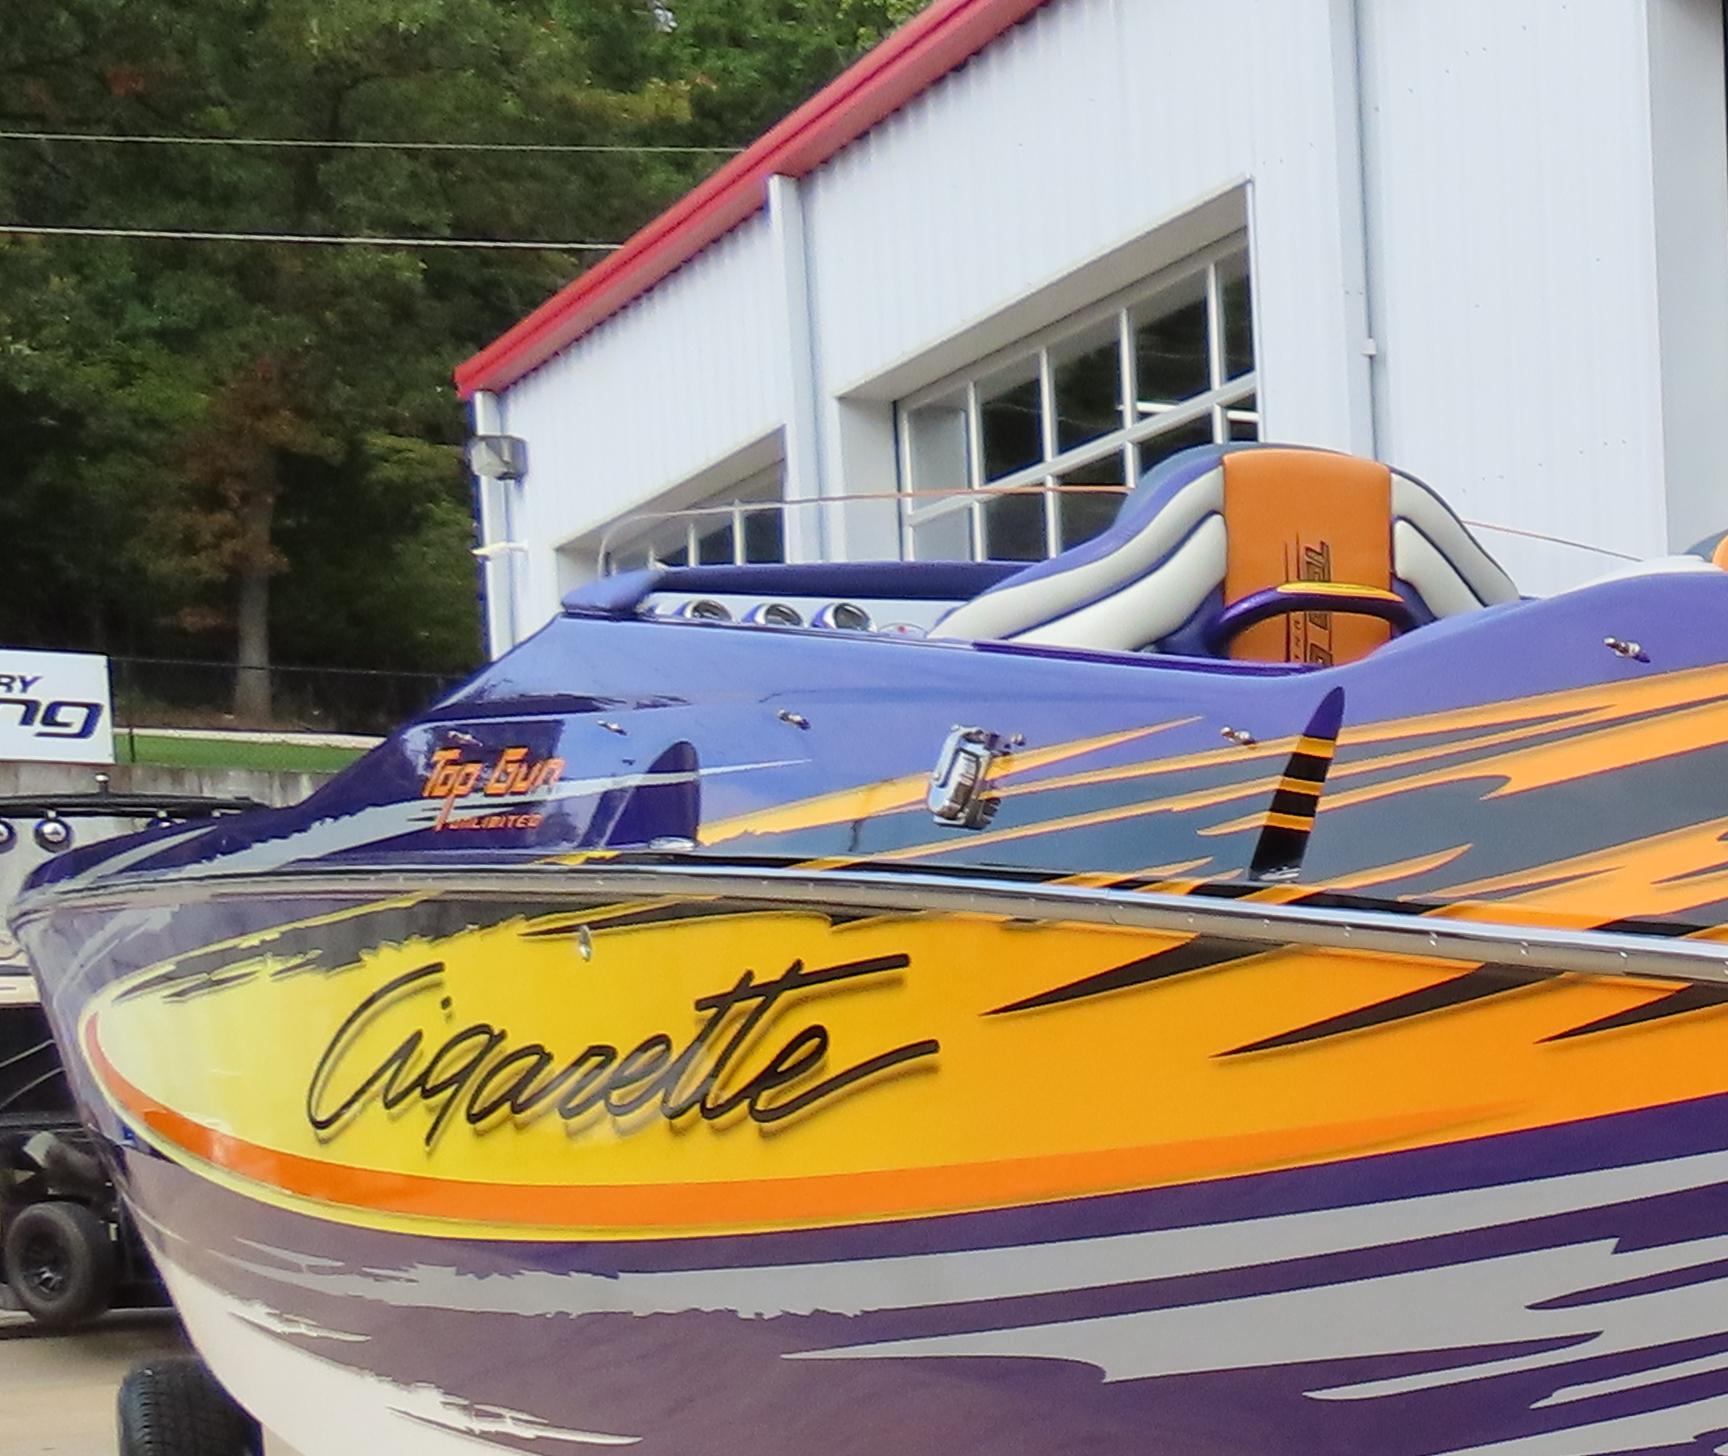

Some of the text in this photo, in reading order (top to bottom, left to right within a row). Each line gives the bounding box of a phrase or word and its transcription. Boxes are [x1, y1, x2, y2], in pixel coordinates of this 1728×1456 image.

[422, 746, 566, 832] Top Gun
[306, 953, 940, 1148] Cigarette
